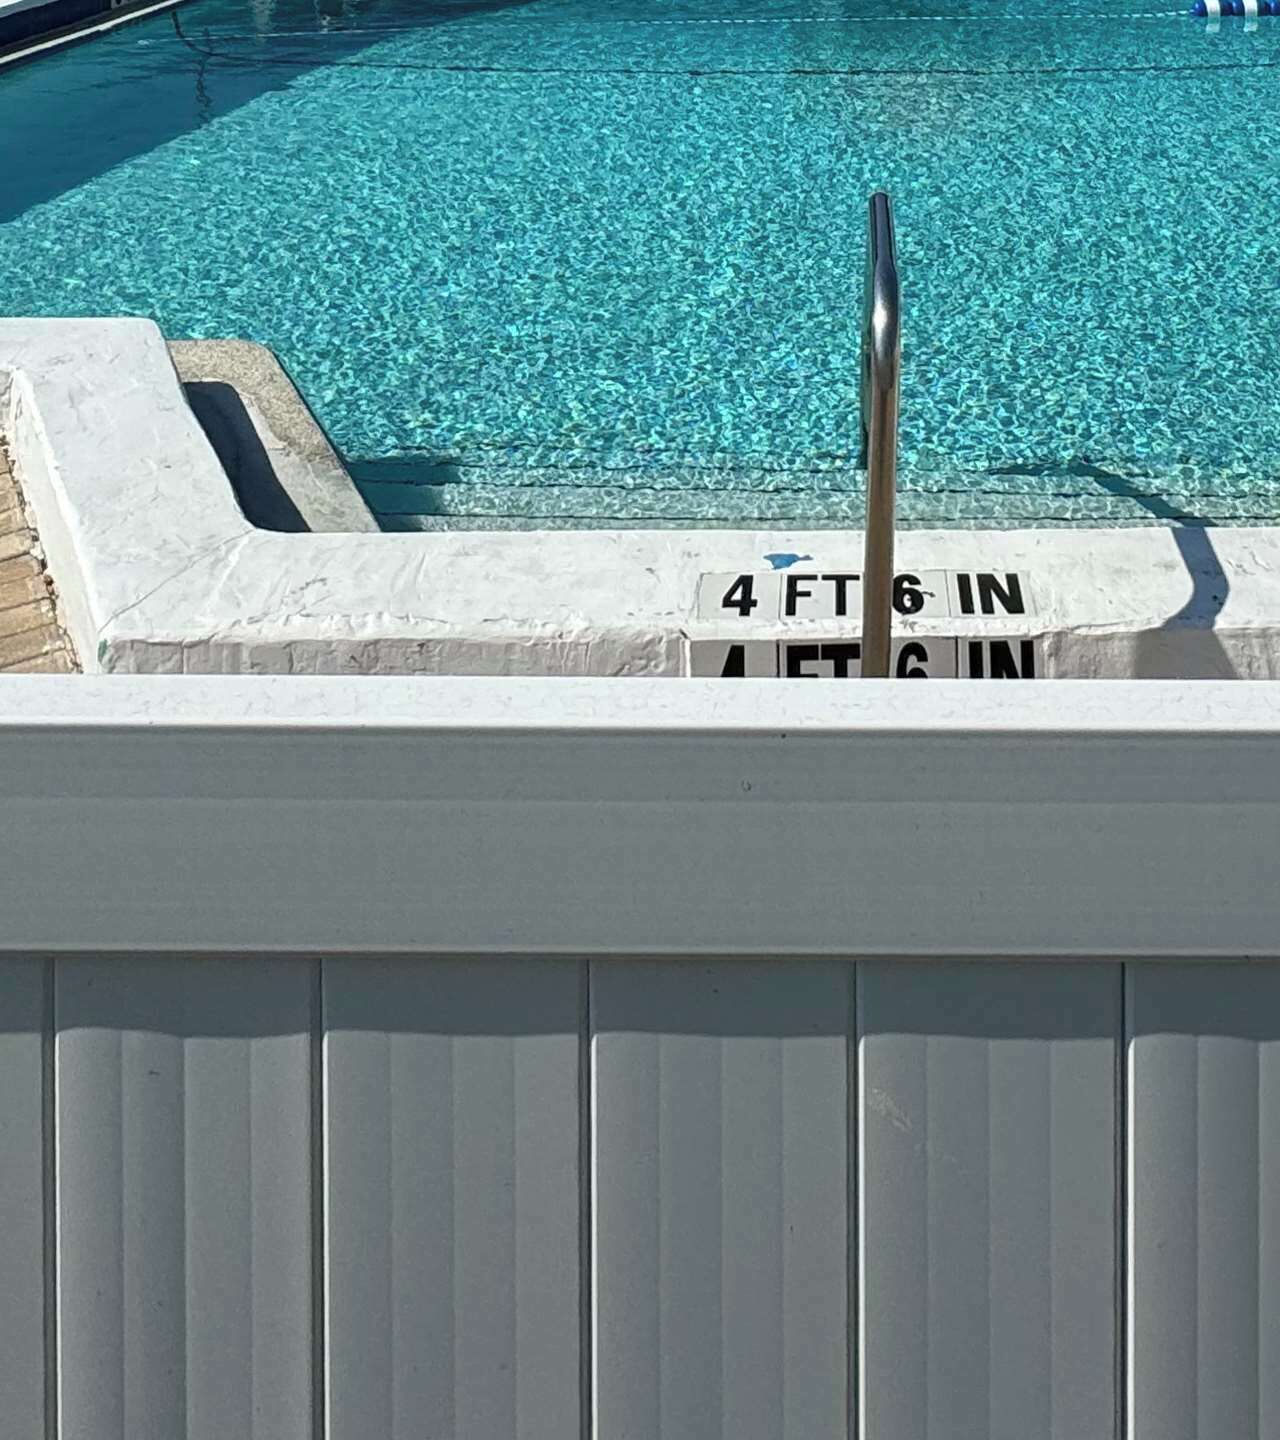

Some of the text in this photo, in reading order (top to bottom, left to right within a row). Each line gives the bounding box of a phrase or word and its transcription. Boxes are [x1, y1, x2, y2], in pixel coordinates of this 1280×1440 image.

[721, 573, 1025, 617] 4 FT 6 IN
